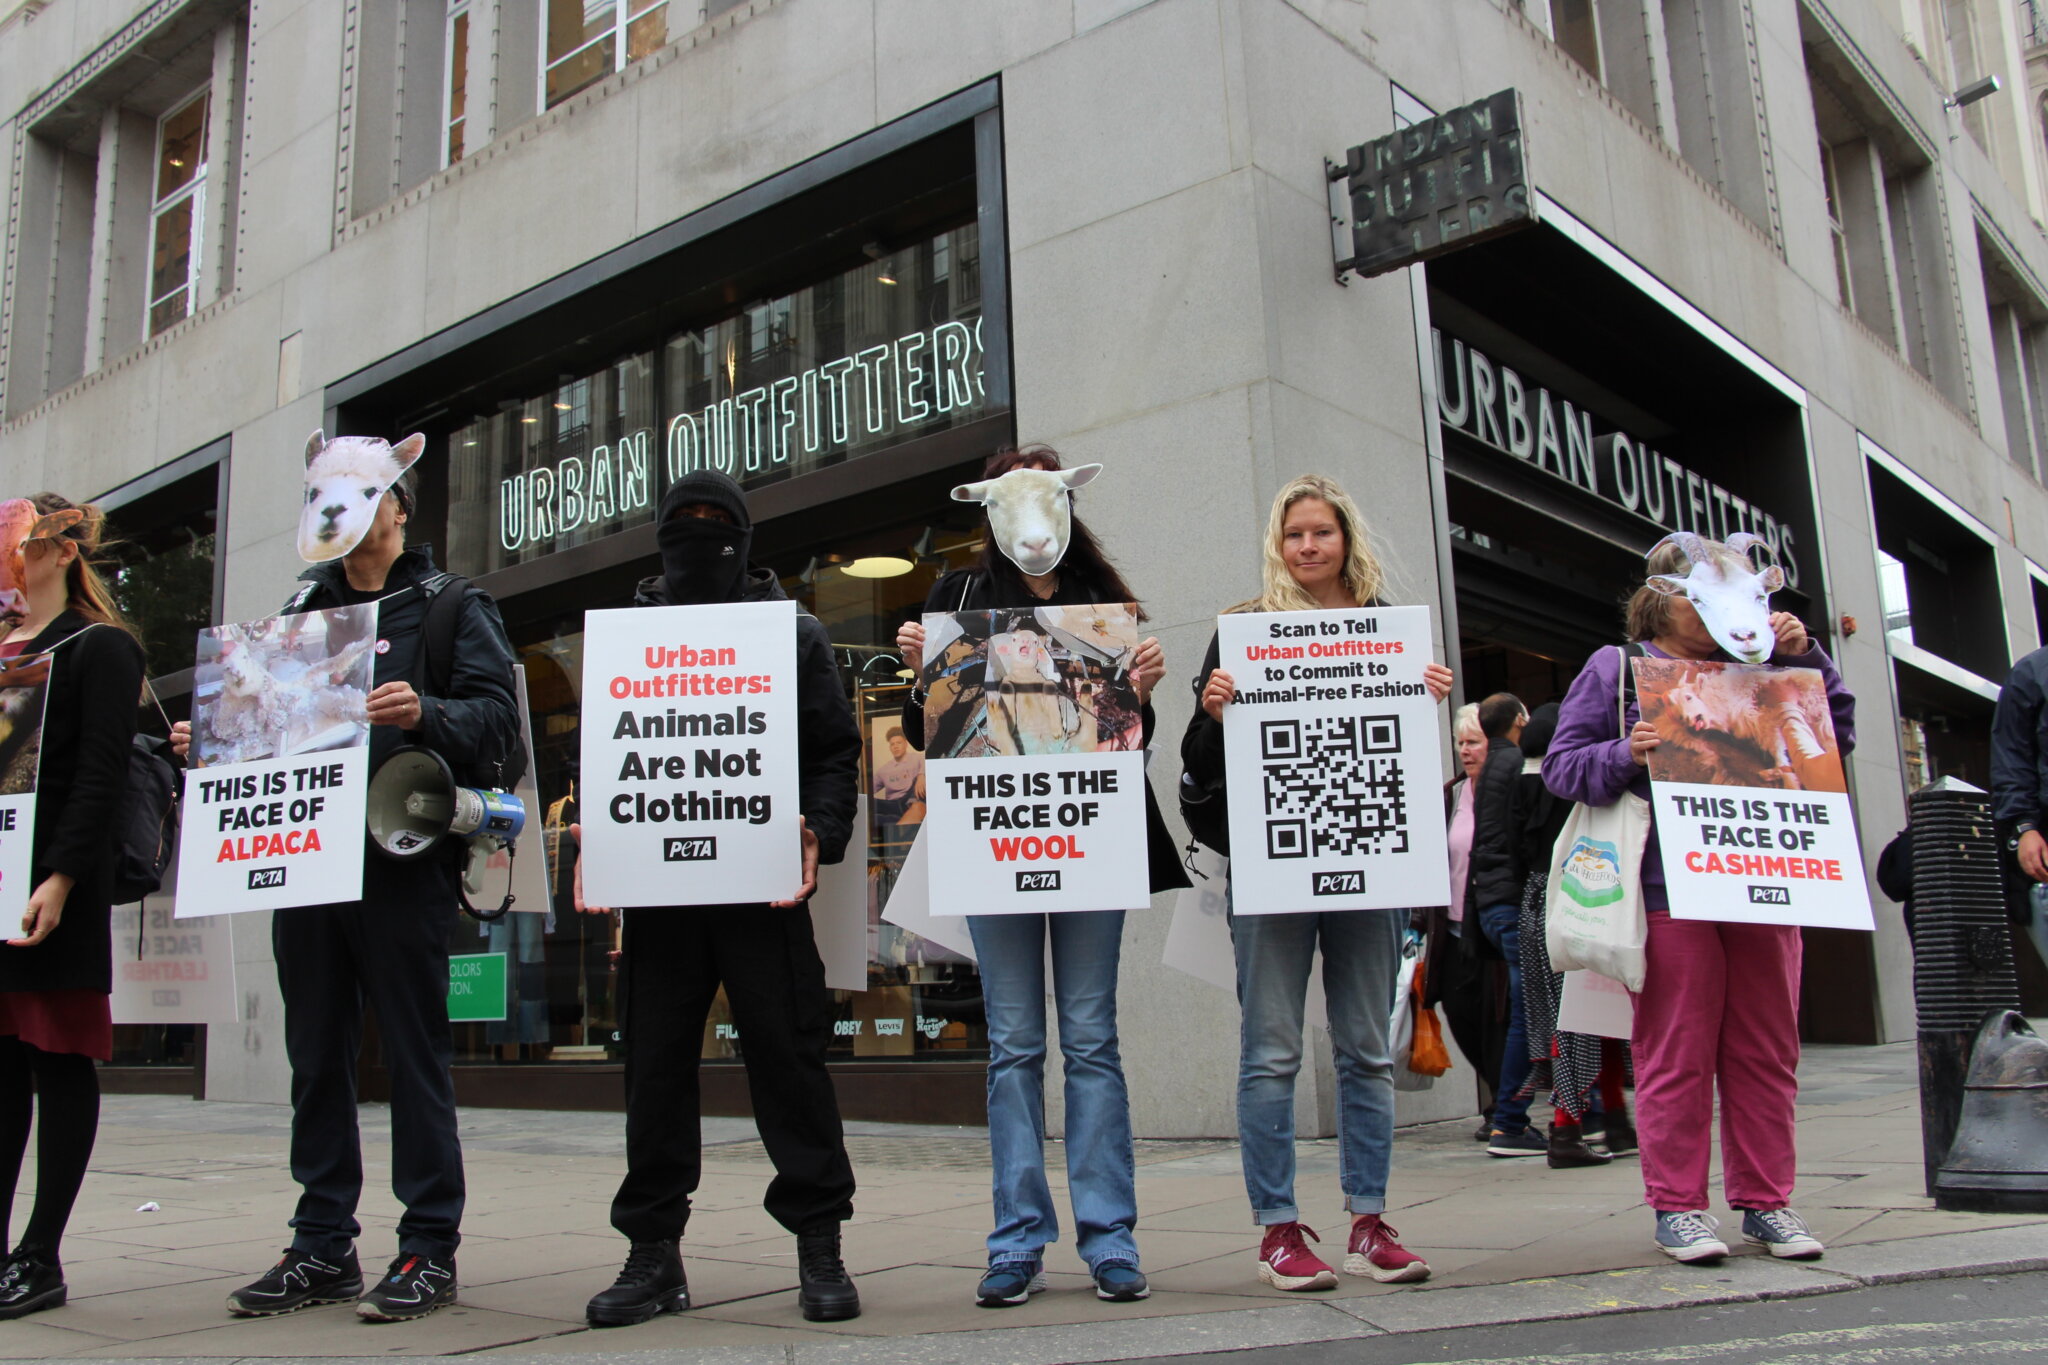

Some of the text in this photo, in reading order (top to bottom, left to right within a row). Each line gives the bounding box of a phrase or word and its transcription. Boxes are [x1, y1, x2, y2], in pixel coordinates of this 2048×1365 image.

[1431, 326, 1798, 588] URBAN OUTFITTERS
[500, 430, 651, 551] URBAN
[1270, 618, 1377, 639] Scan to Tell
[645, 644, 736, 669] Urban
[1246, 639, 1404, 661] Urban Outfitters
[1264, 661, 1388, 681] to Commit to
[609, 673, 772, 700] Outfitters:
[1231, 680, 1426, 705] Animal-Free Fashion
[612, 705, 767, 740] Animals
[618, 748, 762, 781] Are Not
[199, 763, 344, 804] THIS IS THE
[944, 769, 1119, 800] THIS IS THE
[218, 796, 325, 832] FACE OF
[609, 789, 772, 825] Clothing
[973, 801, 1099, 831] FACE OF
[1671, 795, 1830, 825] THIS IS THE
[216, 828, 322, 863] ALPACA
[989, 834, 1085, 862] WOOL
[1701, 824, 1815, 851] FACE OF
[1685, 851, 1843, 881] CASHMERE
[449, 962, 482, 978] OLORS
[449, 981, 473, 996] TON.
